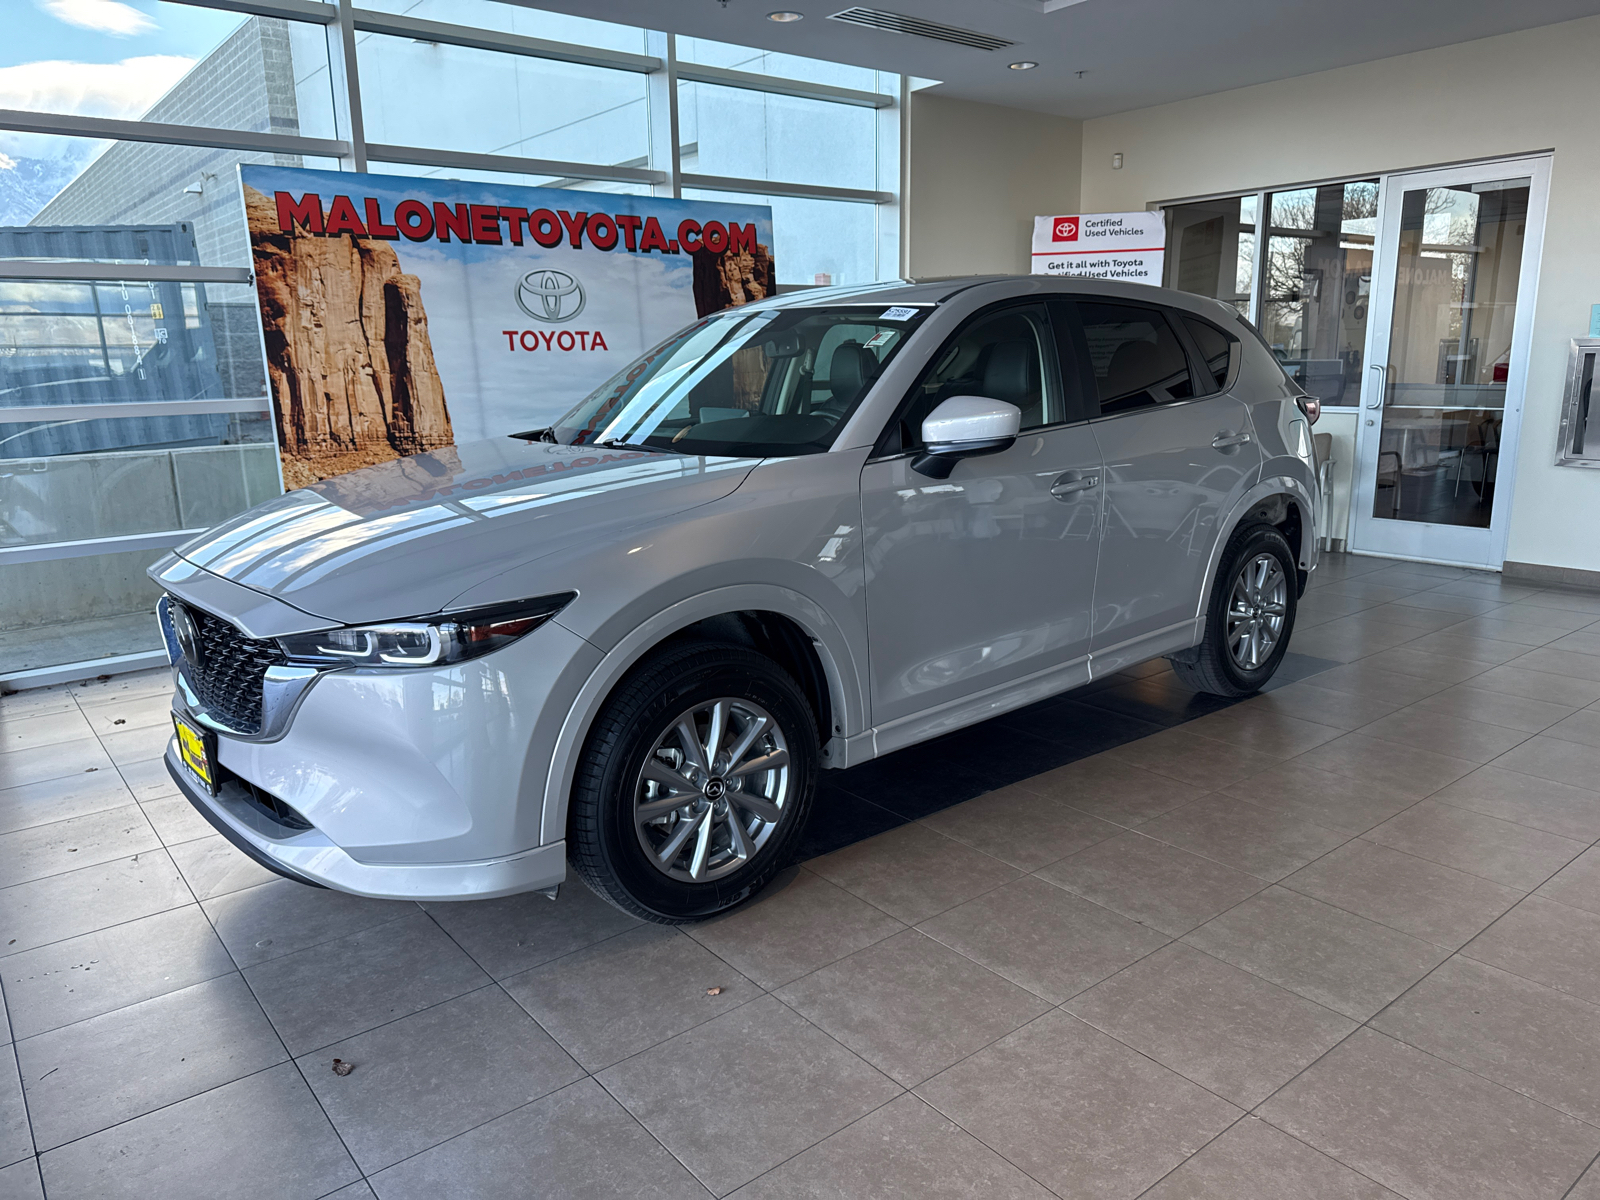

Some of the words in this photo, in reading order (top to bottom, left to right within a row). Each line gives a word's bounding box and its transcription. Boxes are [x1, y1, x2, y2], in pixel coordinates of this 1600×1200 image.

[274, 190, 759, 257] MALONETOYOTA.COM
[1085, 218, 1123, 228] Certified
[1085, 229, 1107, 237] Used
[1108, 228, 1144, 236] Vehicles
[1048, 262, 1065, 270] Get
[1066, 261, 1073, 269] it
[1075, 260, 1087, 269] all
[1089, 260, 1110, 268] with
[1112, 259, 1143, 269] Toyota
[1084, 270, 1108, 278] Used
[1110, 269, 1148, 277] Vehicles
[502, 329, 609, 353] TOYOTA
